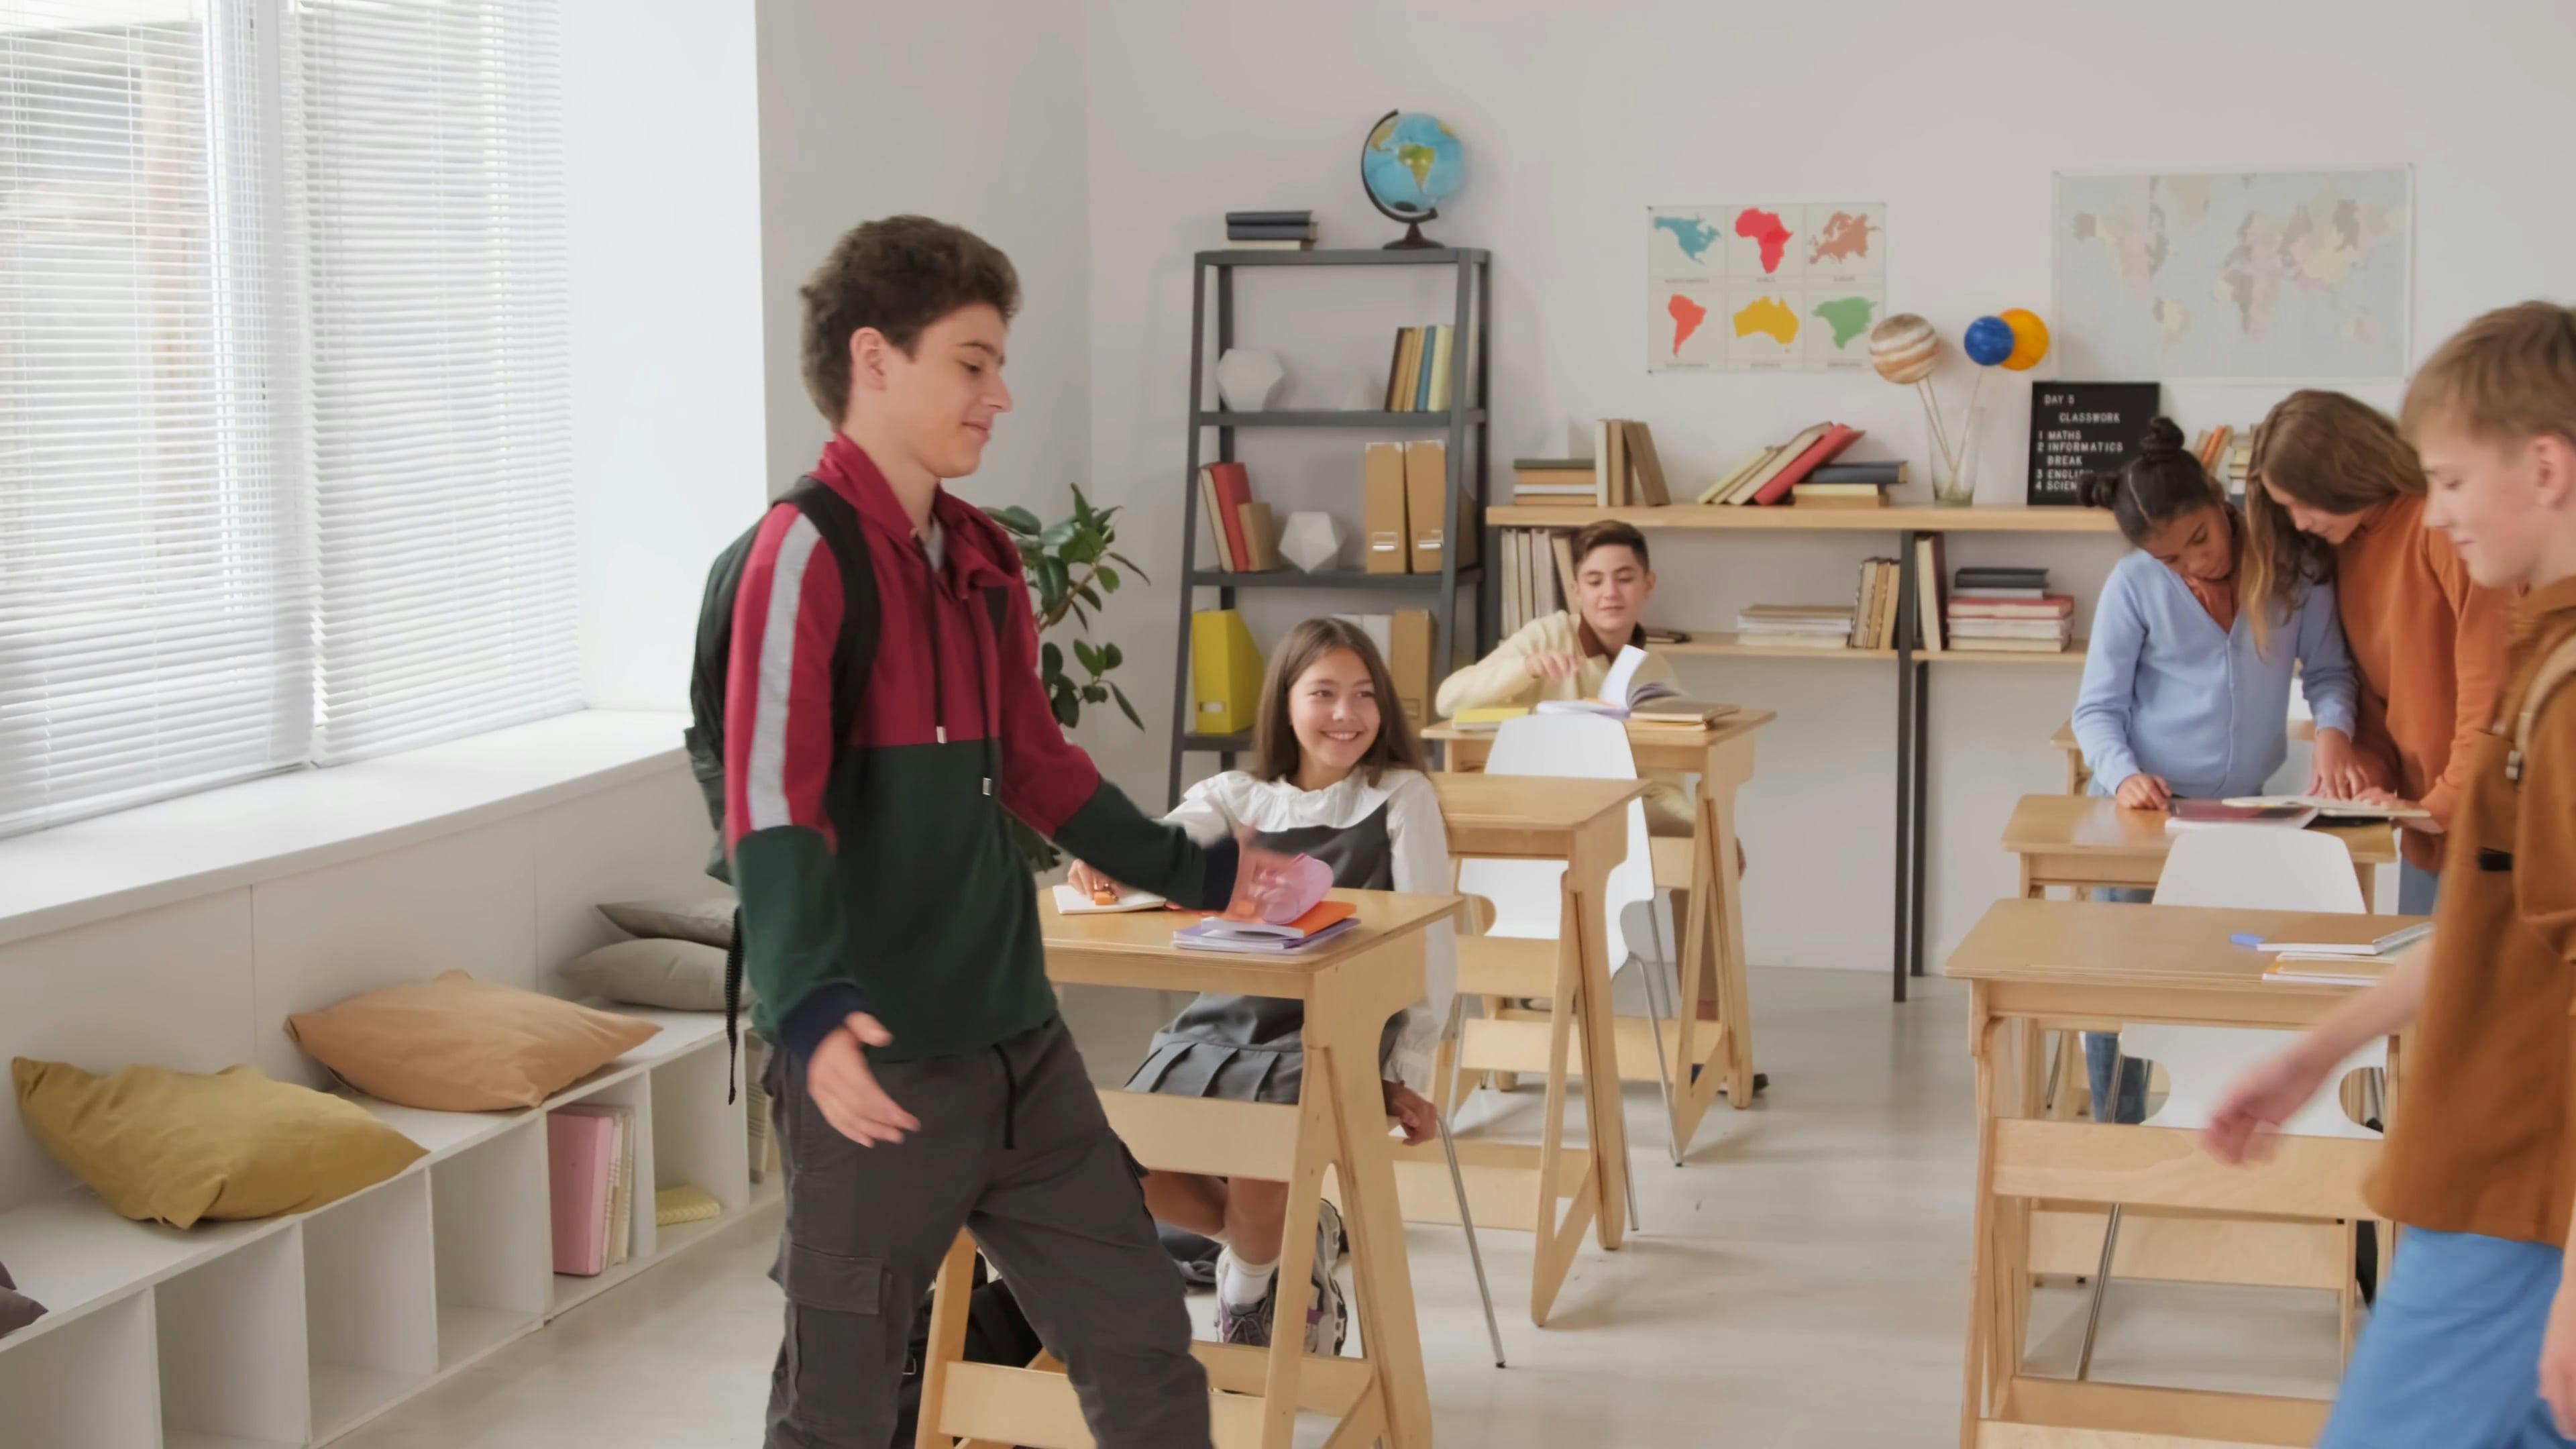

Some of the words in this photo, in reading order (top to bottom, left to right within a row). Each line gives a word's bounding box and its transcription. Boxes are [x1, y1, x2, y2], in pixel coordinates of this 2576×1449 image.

[2044, 394, 2063, 405] DAY
[2059, 412, 2120, 423] CLASSWORK
[2047, 430, 2082, 441] MATHS
[2037, 441, 2044, 452] 2
[2049, 441, 2123, 452] INFORMATICS
[2047, 455, 2082, 466] BREAK
[2037, 469, 2043, 480] 3
[2047, 469, 2093, 480] ENGLI
[2035, 481, 2042, 491] 4
